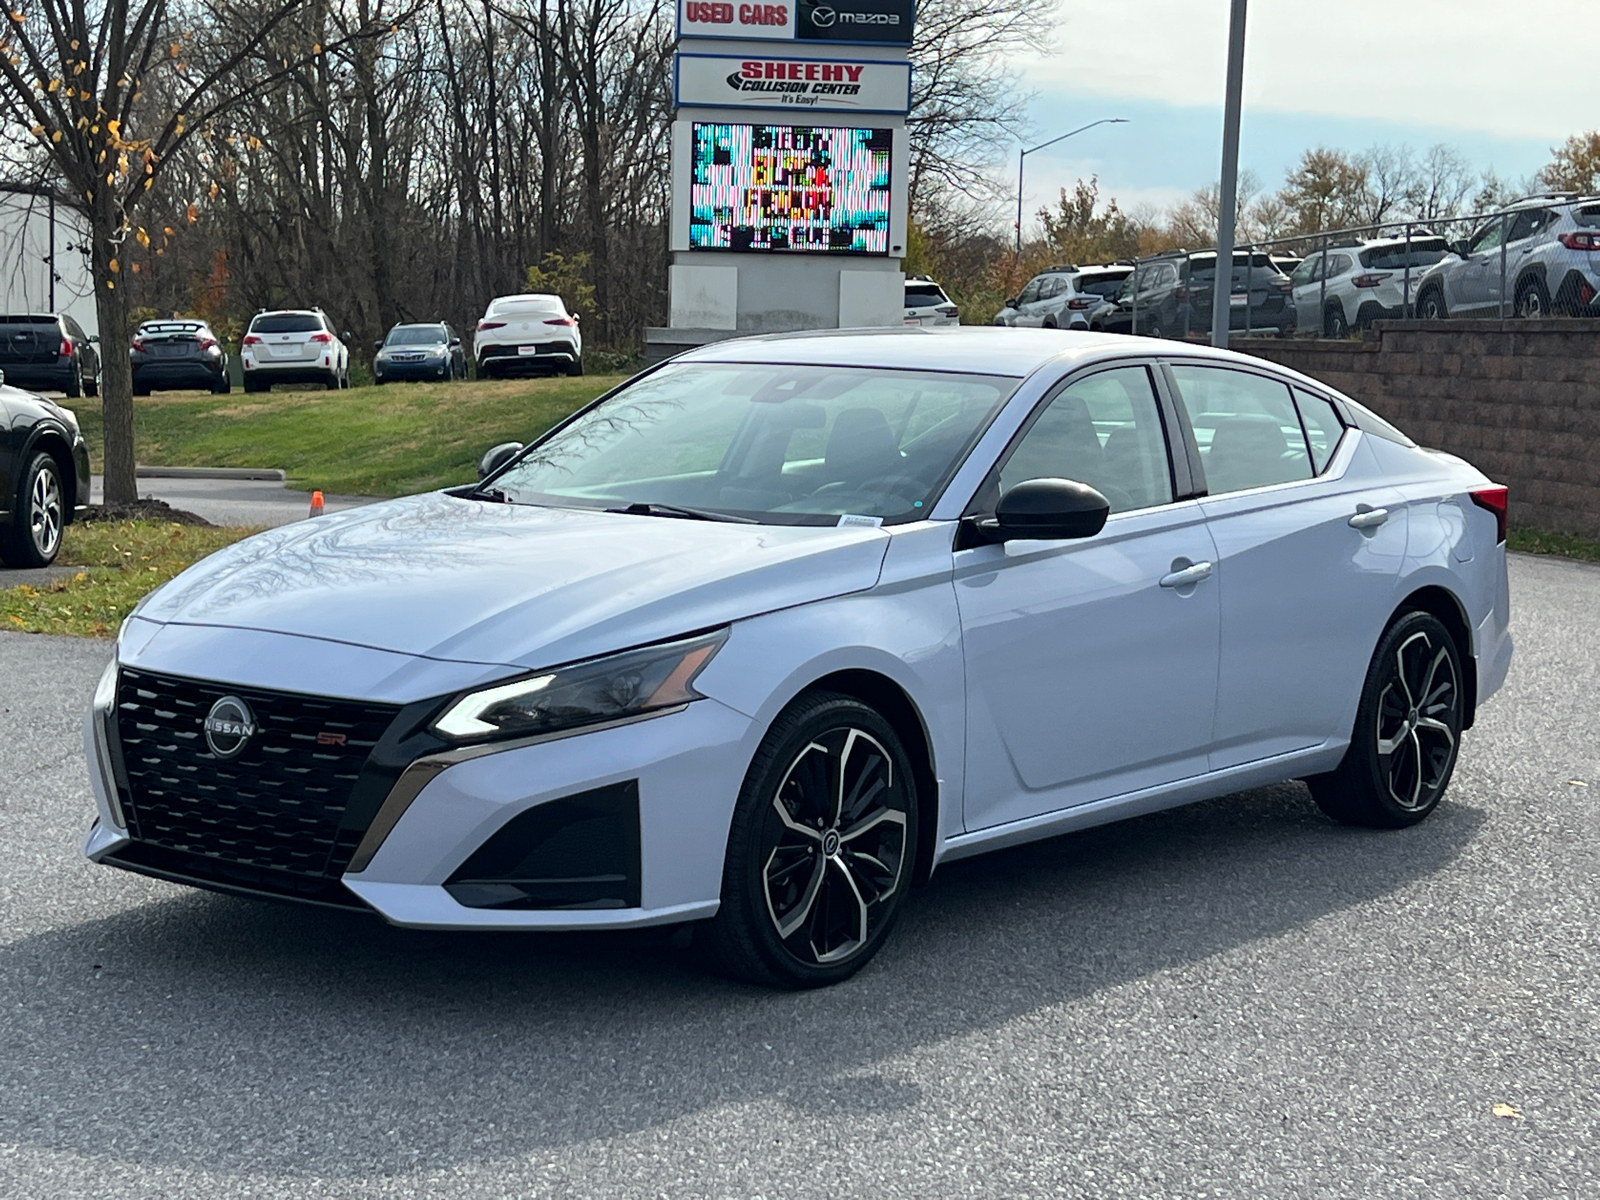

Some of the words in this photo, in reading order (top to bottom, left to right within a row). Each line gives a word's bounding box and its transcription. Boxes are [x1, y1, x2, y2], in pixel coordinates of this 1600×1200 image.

[686, 1, 734, 24] USED
[738, 3, 788, 27] CARS
[839, 12, 900, 25] mazda
[741, 61, 865, 82] SHEEHY
[741, 80, 809, 94] COLLISION
[811, 82, 862, 96] CENTER
[781, 94, 795, 105] It's
[795, 95, 819, 107] Easy!
[204, 719, 253, 736] NISSAN
[317, 731, 347, 747] SR
